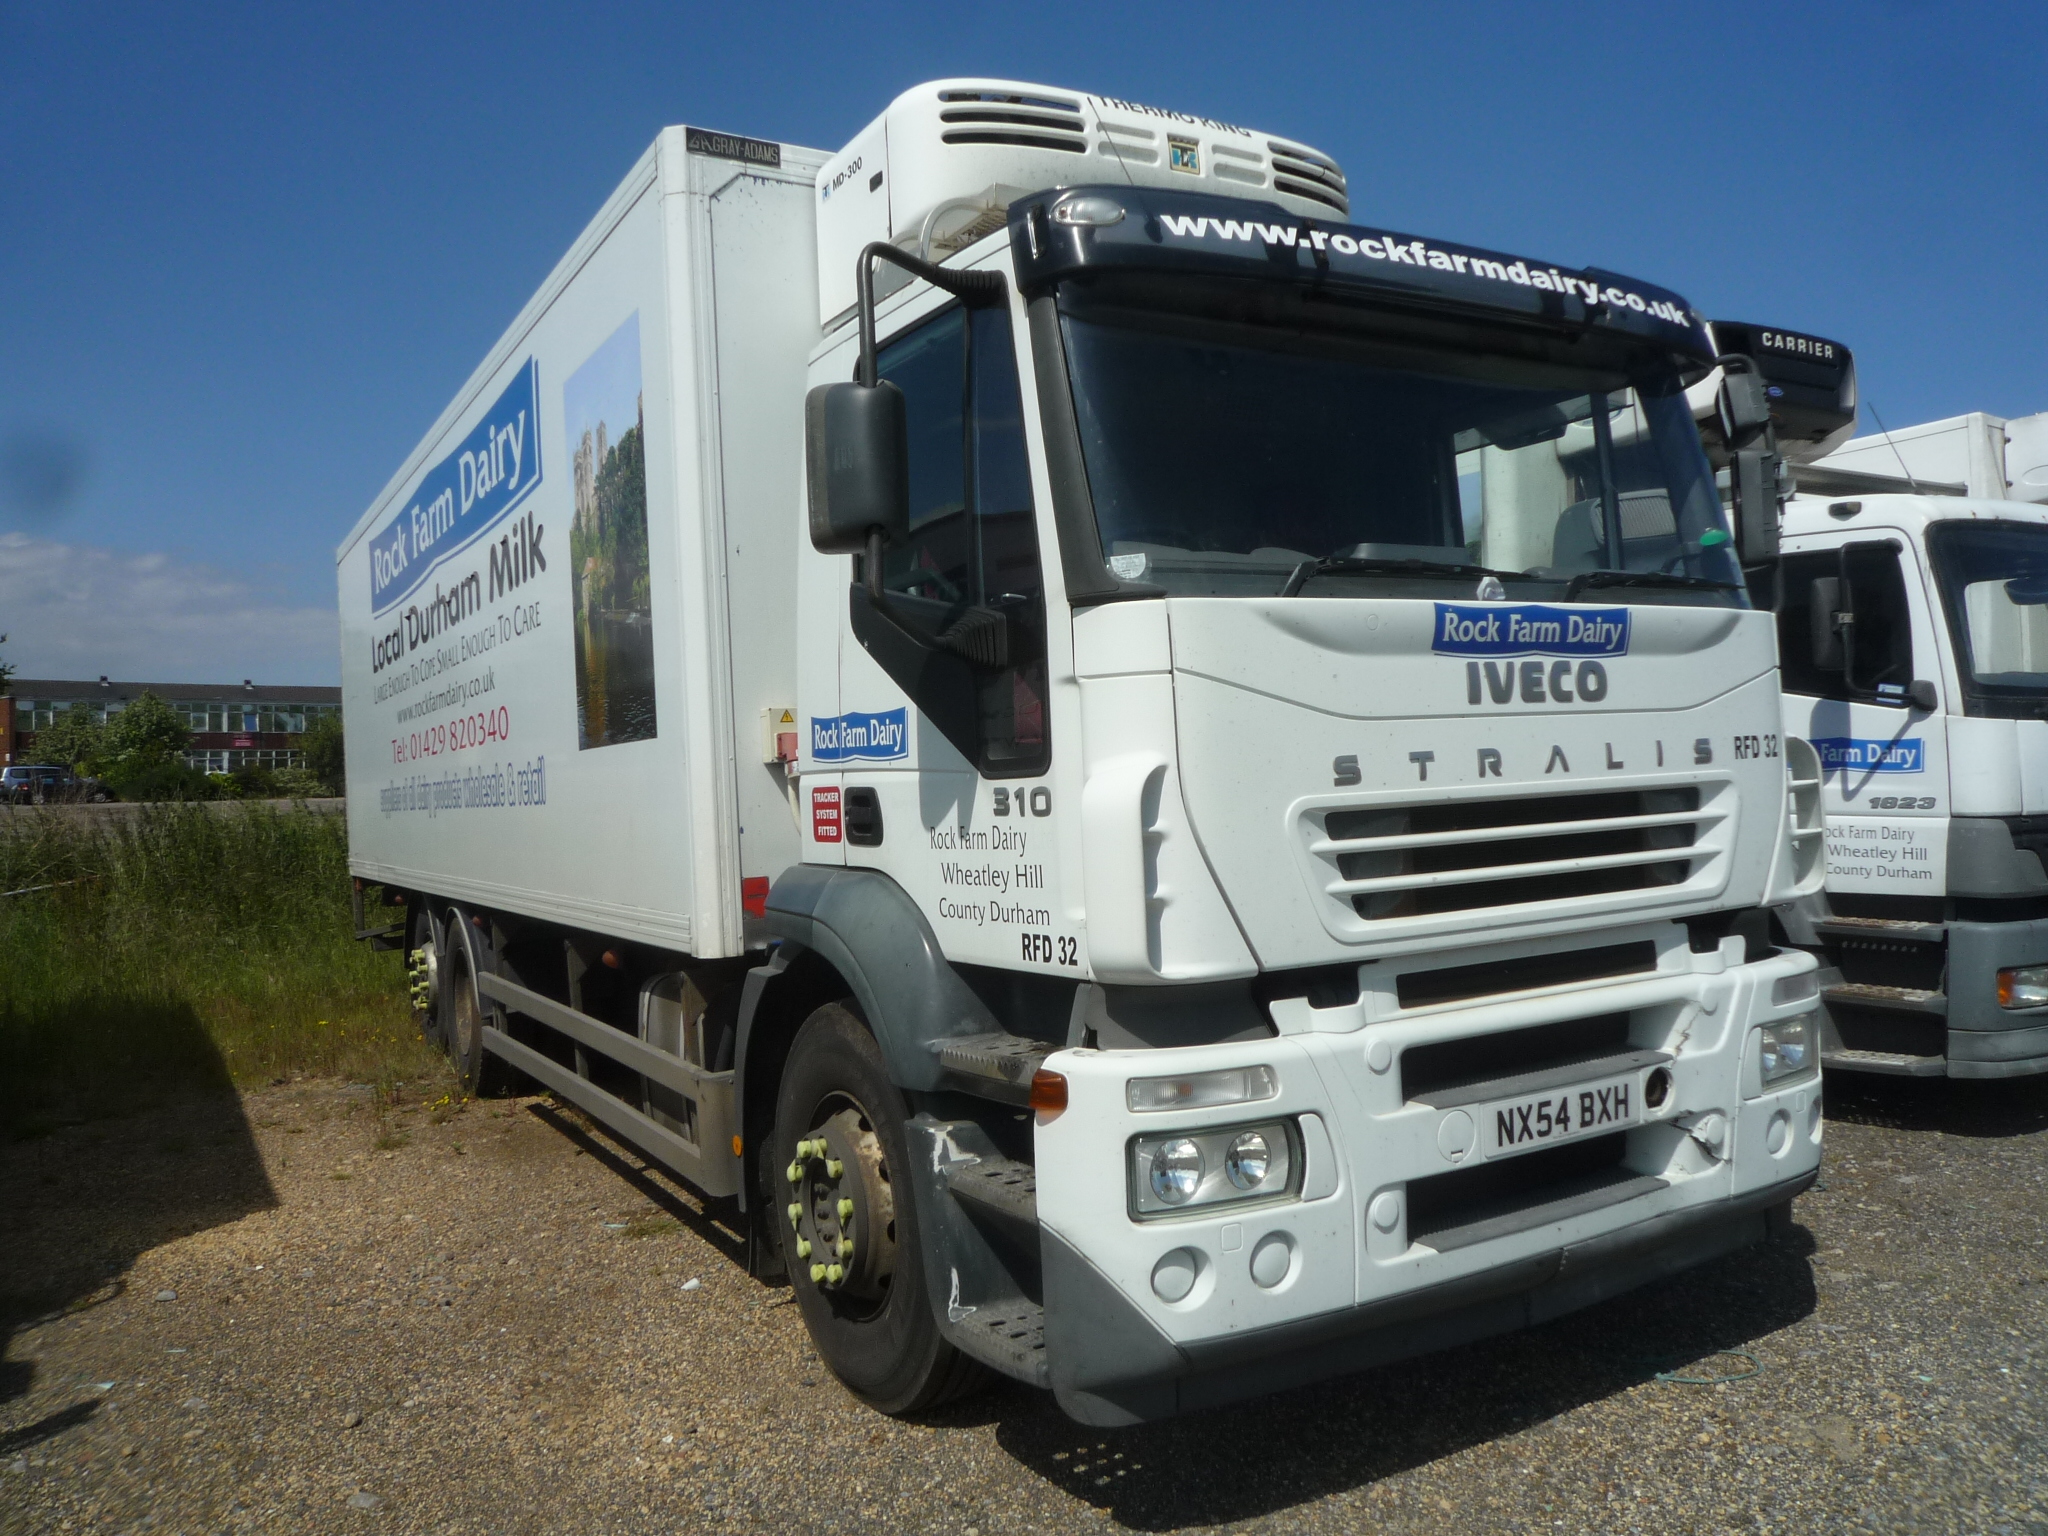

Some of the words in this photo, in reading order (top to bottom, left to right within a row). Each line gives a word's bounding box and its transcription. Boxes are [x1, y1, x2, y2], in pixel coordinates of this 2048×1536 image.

[712, 136, 779, 163] GRAY-ADAMS
[832, 156, 863, 192] MD-300
[1160, 214, 1691, 328] www.rockfarmdairy.co.uk
[1762, 332, 1833, 359] CARRIER
[373, 524, 409, 595] Rock
[411, 486, 455, 559] Farm
[459, 409, 525, 516] Dairy
[372, 610, 405, 674] Local
[407, 570, 481, 651] Durham
[489, 510, 547, 603] Milk
[1444, 613, 1501, 643] Rock
[1508, 613, 1561, 643] Farm
[1566, 615, 1623, 651] Dairy
[1466, 660, 1608, 705] IVECO
[391, 739, 408, 764] Tel:
[410, 724, 446, 760] 01429
[450, 705, 509, 751] 820340
[814, 722, 839, 749] Rock
[841, 722, 868, 748] Farm
[870, 718, 903, 752] Dairy
[1734, 735, 1760, 760] RFD
[1763, 734, 1778, 759] 32
[1333, 738, 1713, 787] STRALIS
[1821, 743, 1861, 763] Farm
[1866, 743, 1918, 768] Dairy
[463, 762, 505, 808] wholesale
[517, 755, 547, 806] retail
[814, 792, 839, 802] TRACKER
[816, 809, 838, 820] SYSTEM
[993, 786, 1052, 817] 310
[1868, 797, 1936, 810] 1823
[818, 826, 837, 836] FITTED
[930, 826, 956, 850] Rock
[959, 825, 988, 850] Farm
[992, 825, 1027, 857] Dairy
[1826, 824, 1845, 839] ock
[1849, 825, 1877, 840] Farm
[1881, 826, 1915, 844] Dairy
[1827, 844, 1897, 862] Wheatley
[1902, 847, 1928, 861] Hill
[941, 863, 1010, 893] Wheatley
[1015, 864, 1043, 889] Hill
[1877, 865, 1932, 880] Durham
[939, 898, 985, 926] County
[990, 901, 1051, 926] Durham
[1021, 933, 1053, 963] RFD
[1057, 935, 1078, 966] 32
[1497, 1096, 1571, 1147] NX54
[1579, 1083, 1629, 1129] BXH
